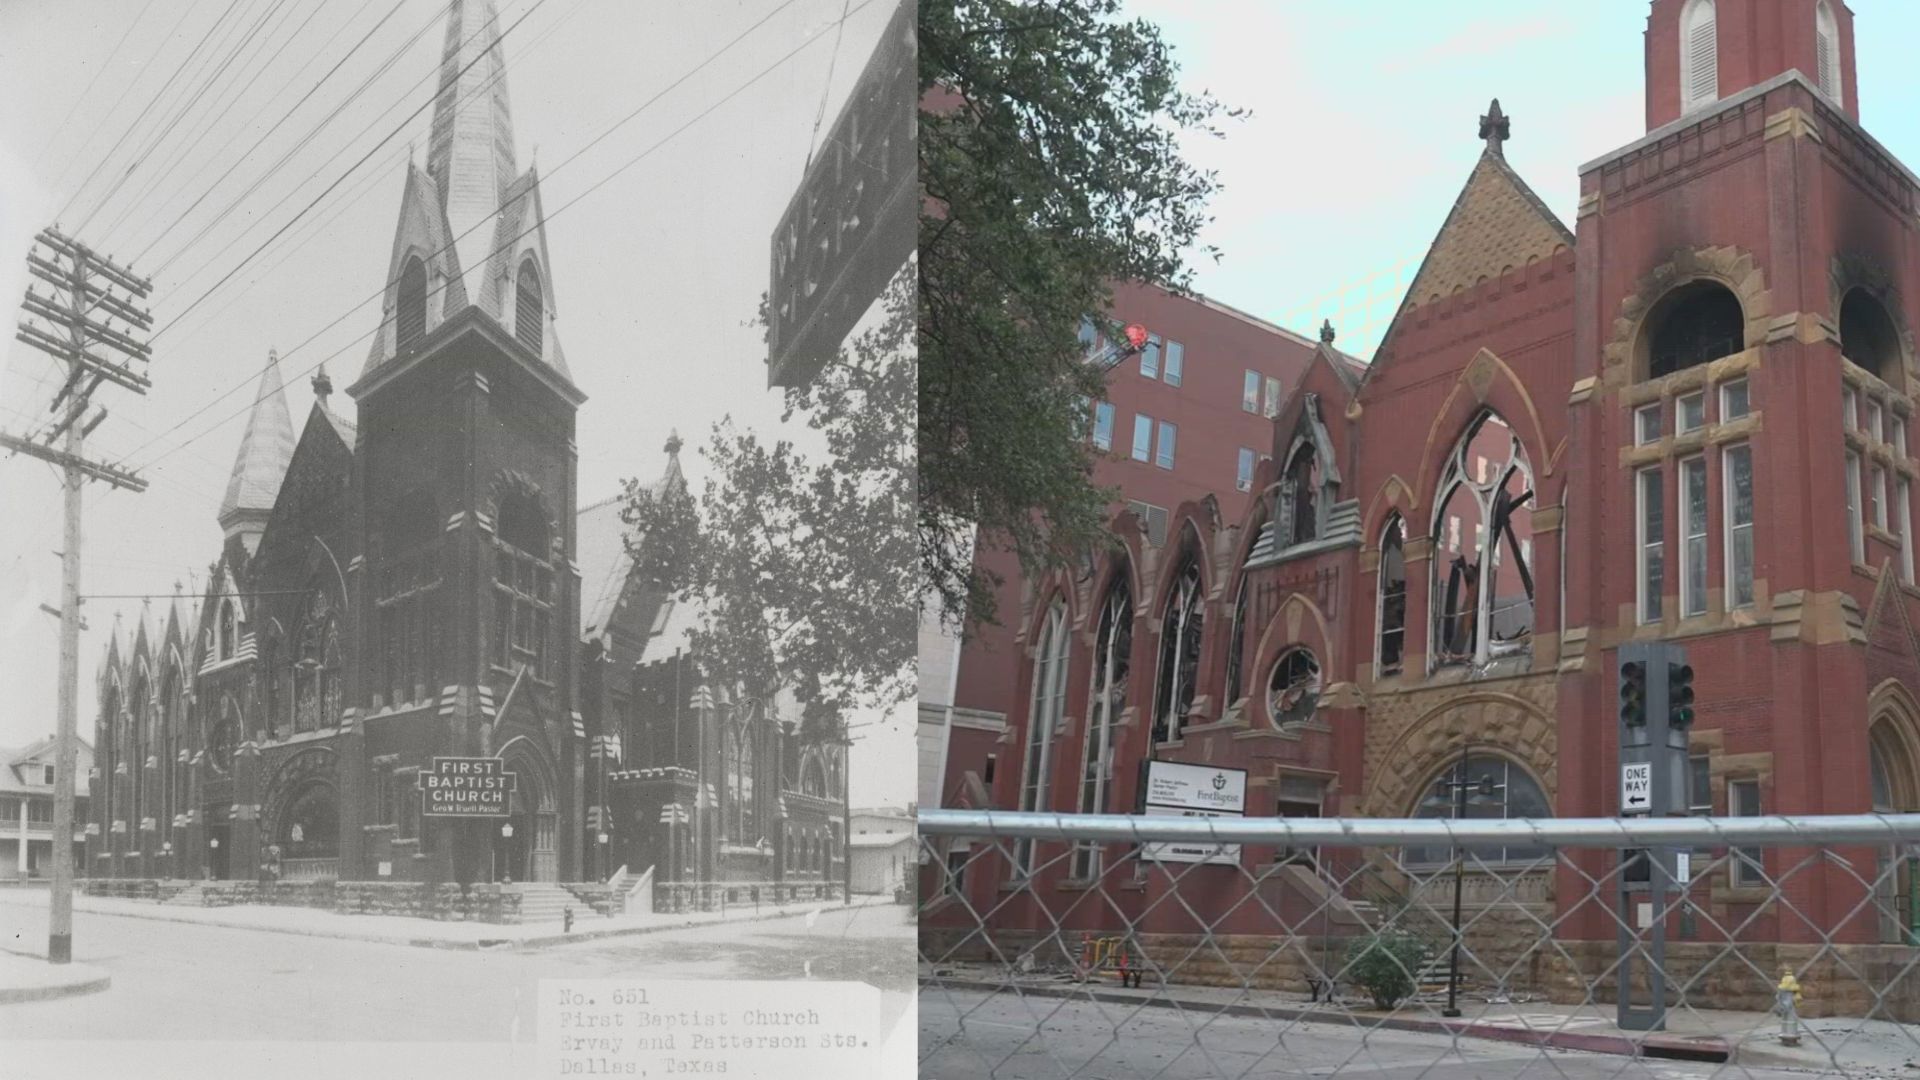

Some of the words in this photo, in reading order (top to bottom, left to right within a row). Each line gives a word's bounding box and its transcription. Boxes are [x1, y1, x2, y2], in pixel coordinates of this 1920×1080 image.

[442, 762, 494, 774] FIRST
[1626, 768, 1647, 779] ONE
[428, 776, 506, 789] BAPTIST
[1625, 780, 1648, 791] WAY
[432, 790, 502, 802] CHURCH
